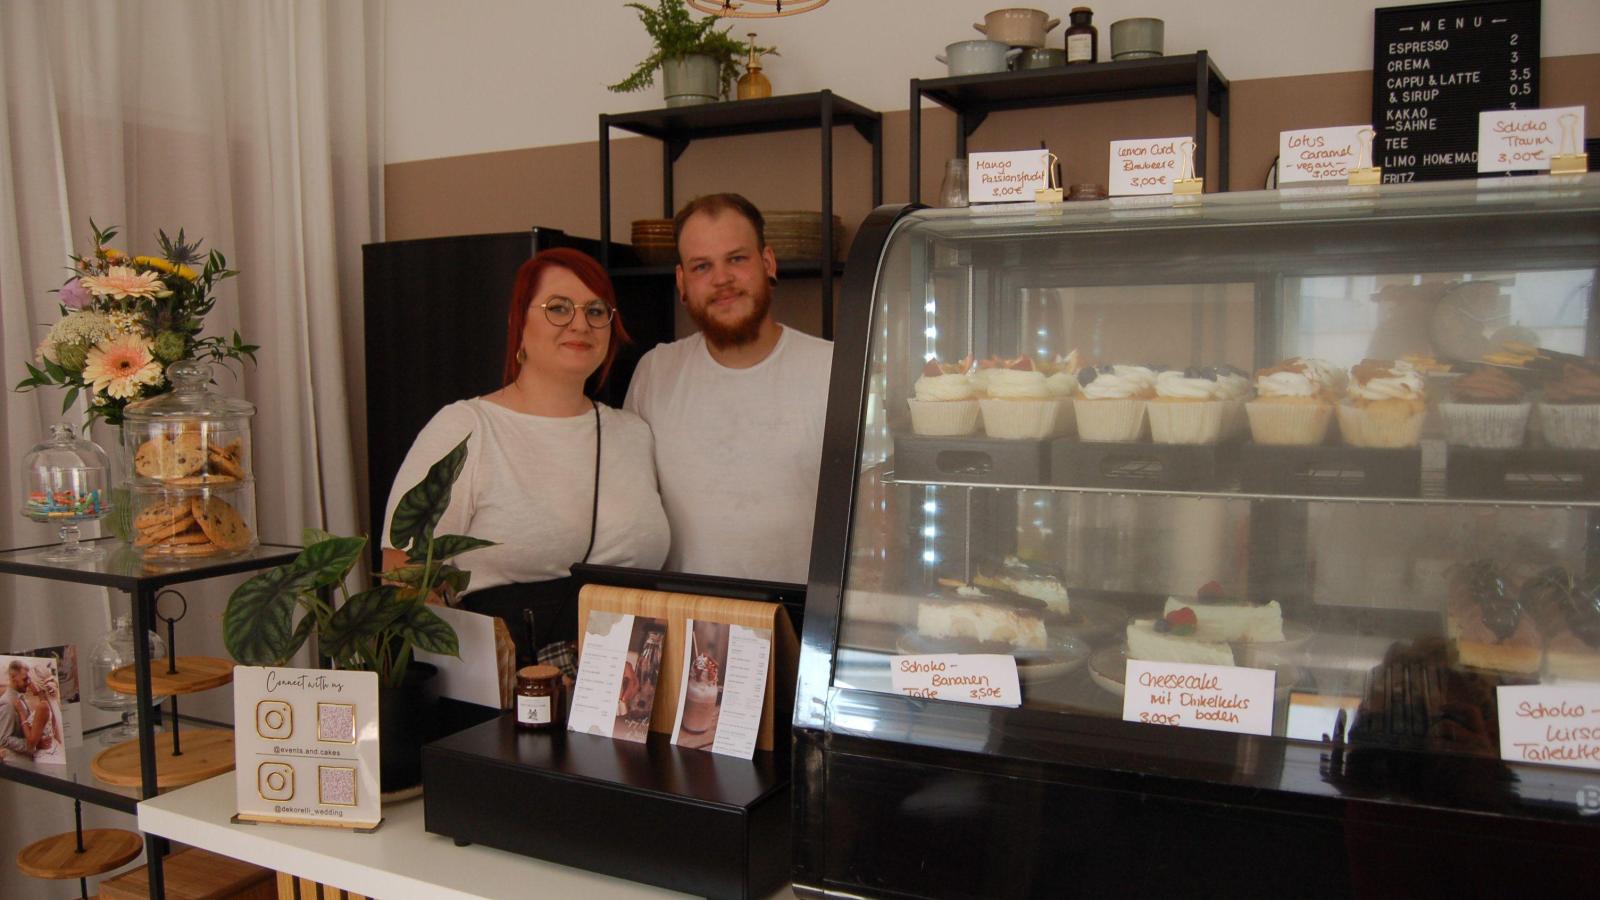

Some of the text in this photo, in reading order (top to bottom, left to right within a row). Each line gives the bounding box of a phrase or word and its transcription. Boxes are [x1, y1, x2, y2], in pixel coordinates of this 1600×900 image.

[1389, 34, 1518, 54] ESPRESSO 2
[1387, 51, 1519, 72] CREMA 3
[1387, 68, 1531, 89] CAPPU & LATTE 3.5
[1389, 83, 1531, 103] & SIRUP 0.5
[1386, 107, 1428, 120] KAKAO
[1395, 118, 1437, 132] SAHNE
[1288, 134, 1325, 148] Lotus
[1385, 137, 1409, 150] TEE
[1502, 135, 1553, 147] Traum
[1150, 143, 1176, 155] Curd
[1385, 152, 1479, 168] LIMO HOMEMAD
[976, 160, 1012, 175] Mango
[1384, 172, 1415, 184] FRITZ
[266, 671, 344, 693] Connect with us
[932, 674, 989, 687] Bananen
[969, 687, 1001, 700] 3,50€
[1150, 690, 1172, 705] mit
[1139, 712, 1181, 726] 3,00€
